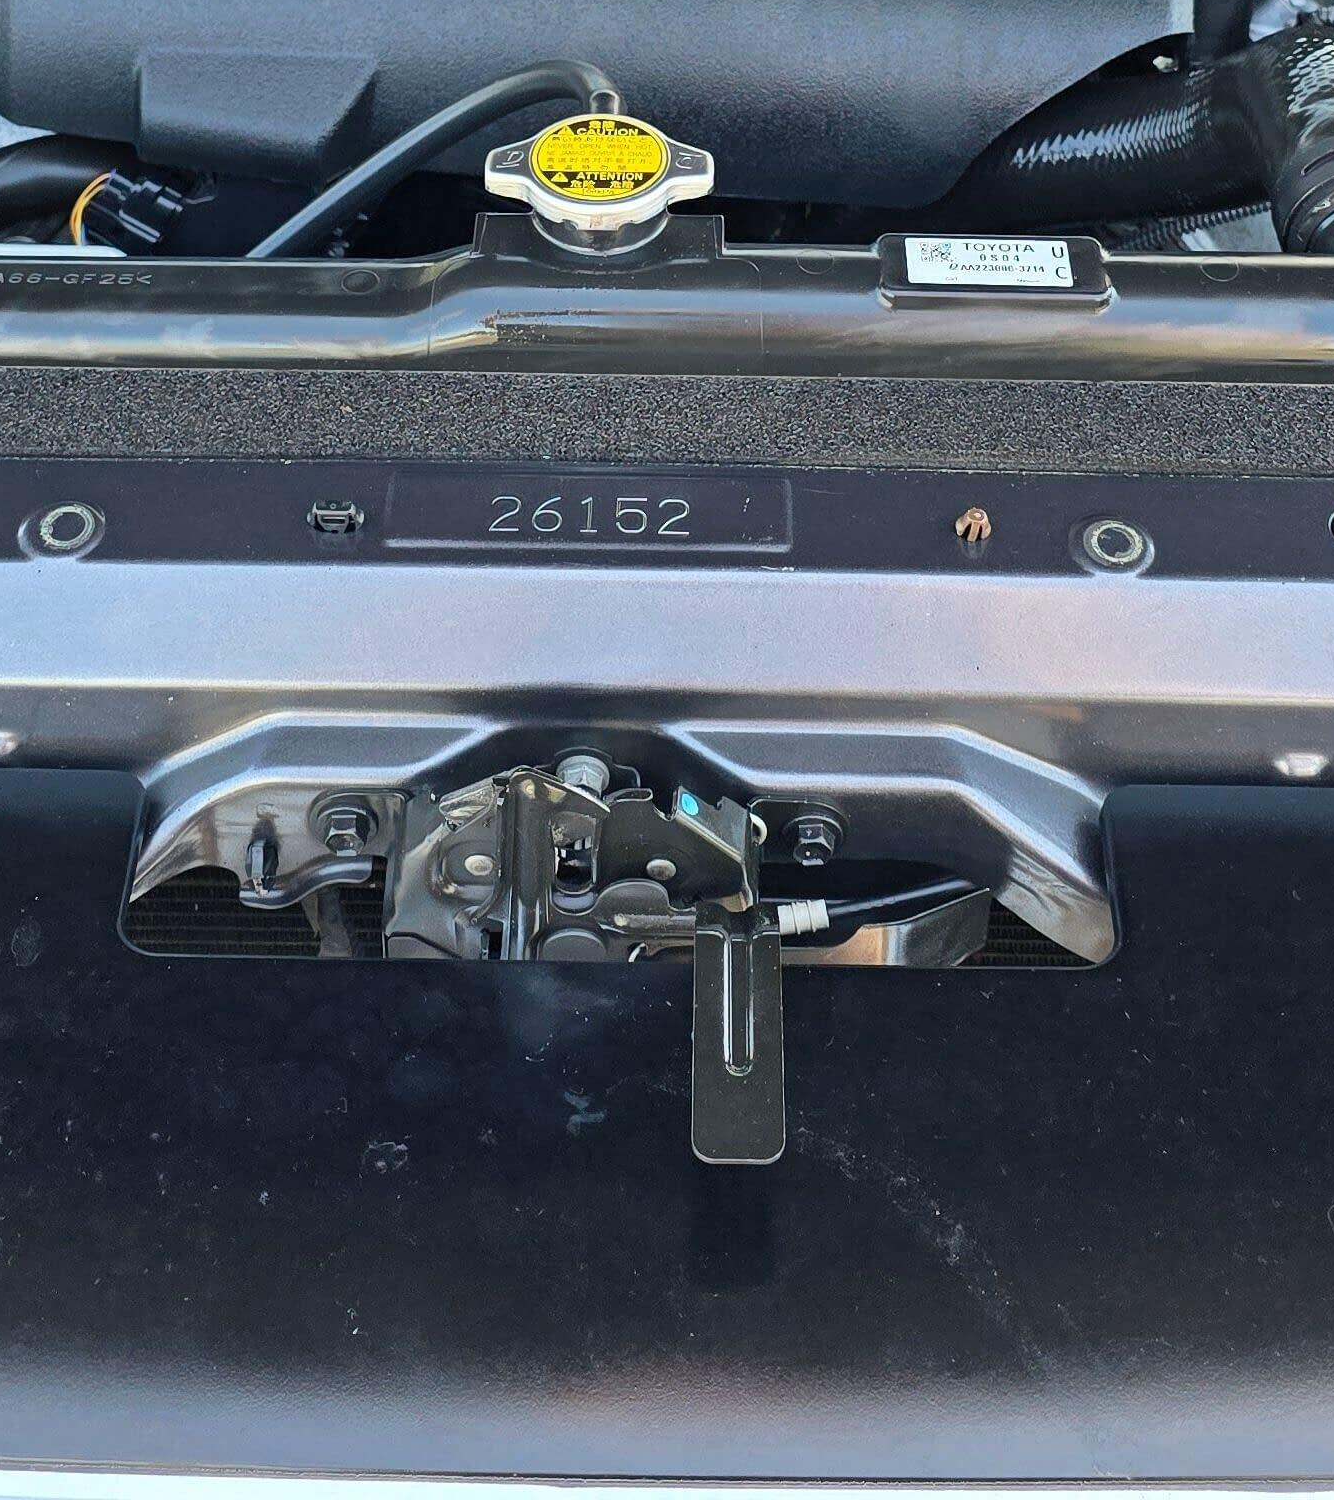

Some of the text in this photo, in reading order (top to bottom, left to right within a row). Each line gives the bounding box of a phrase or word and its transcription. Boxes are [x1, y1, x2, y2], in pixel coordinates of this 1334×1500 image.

[576, 128, 639, 136] CAUTION
[576, 171, 644, 180] ATTENTION
[962, 243, 1065, 259] TOYOTA U
[1055, 266, 1069, 280] C
[488, 495, 690, 536] 26152
